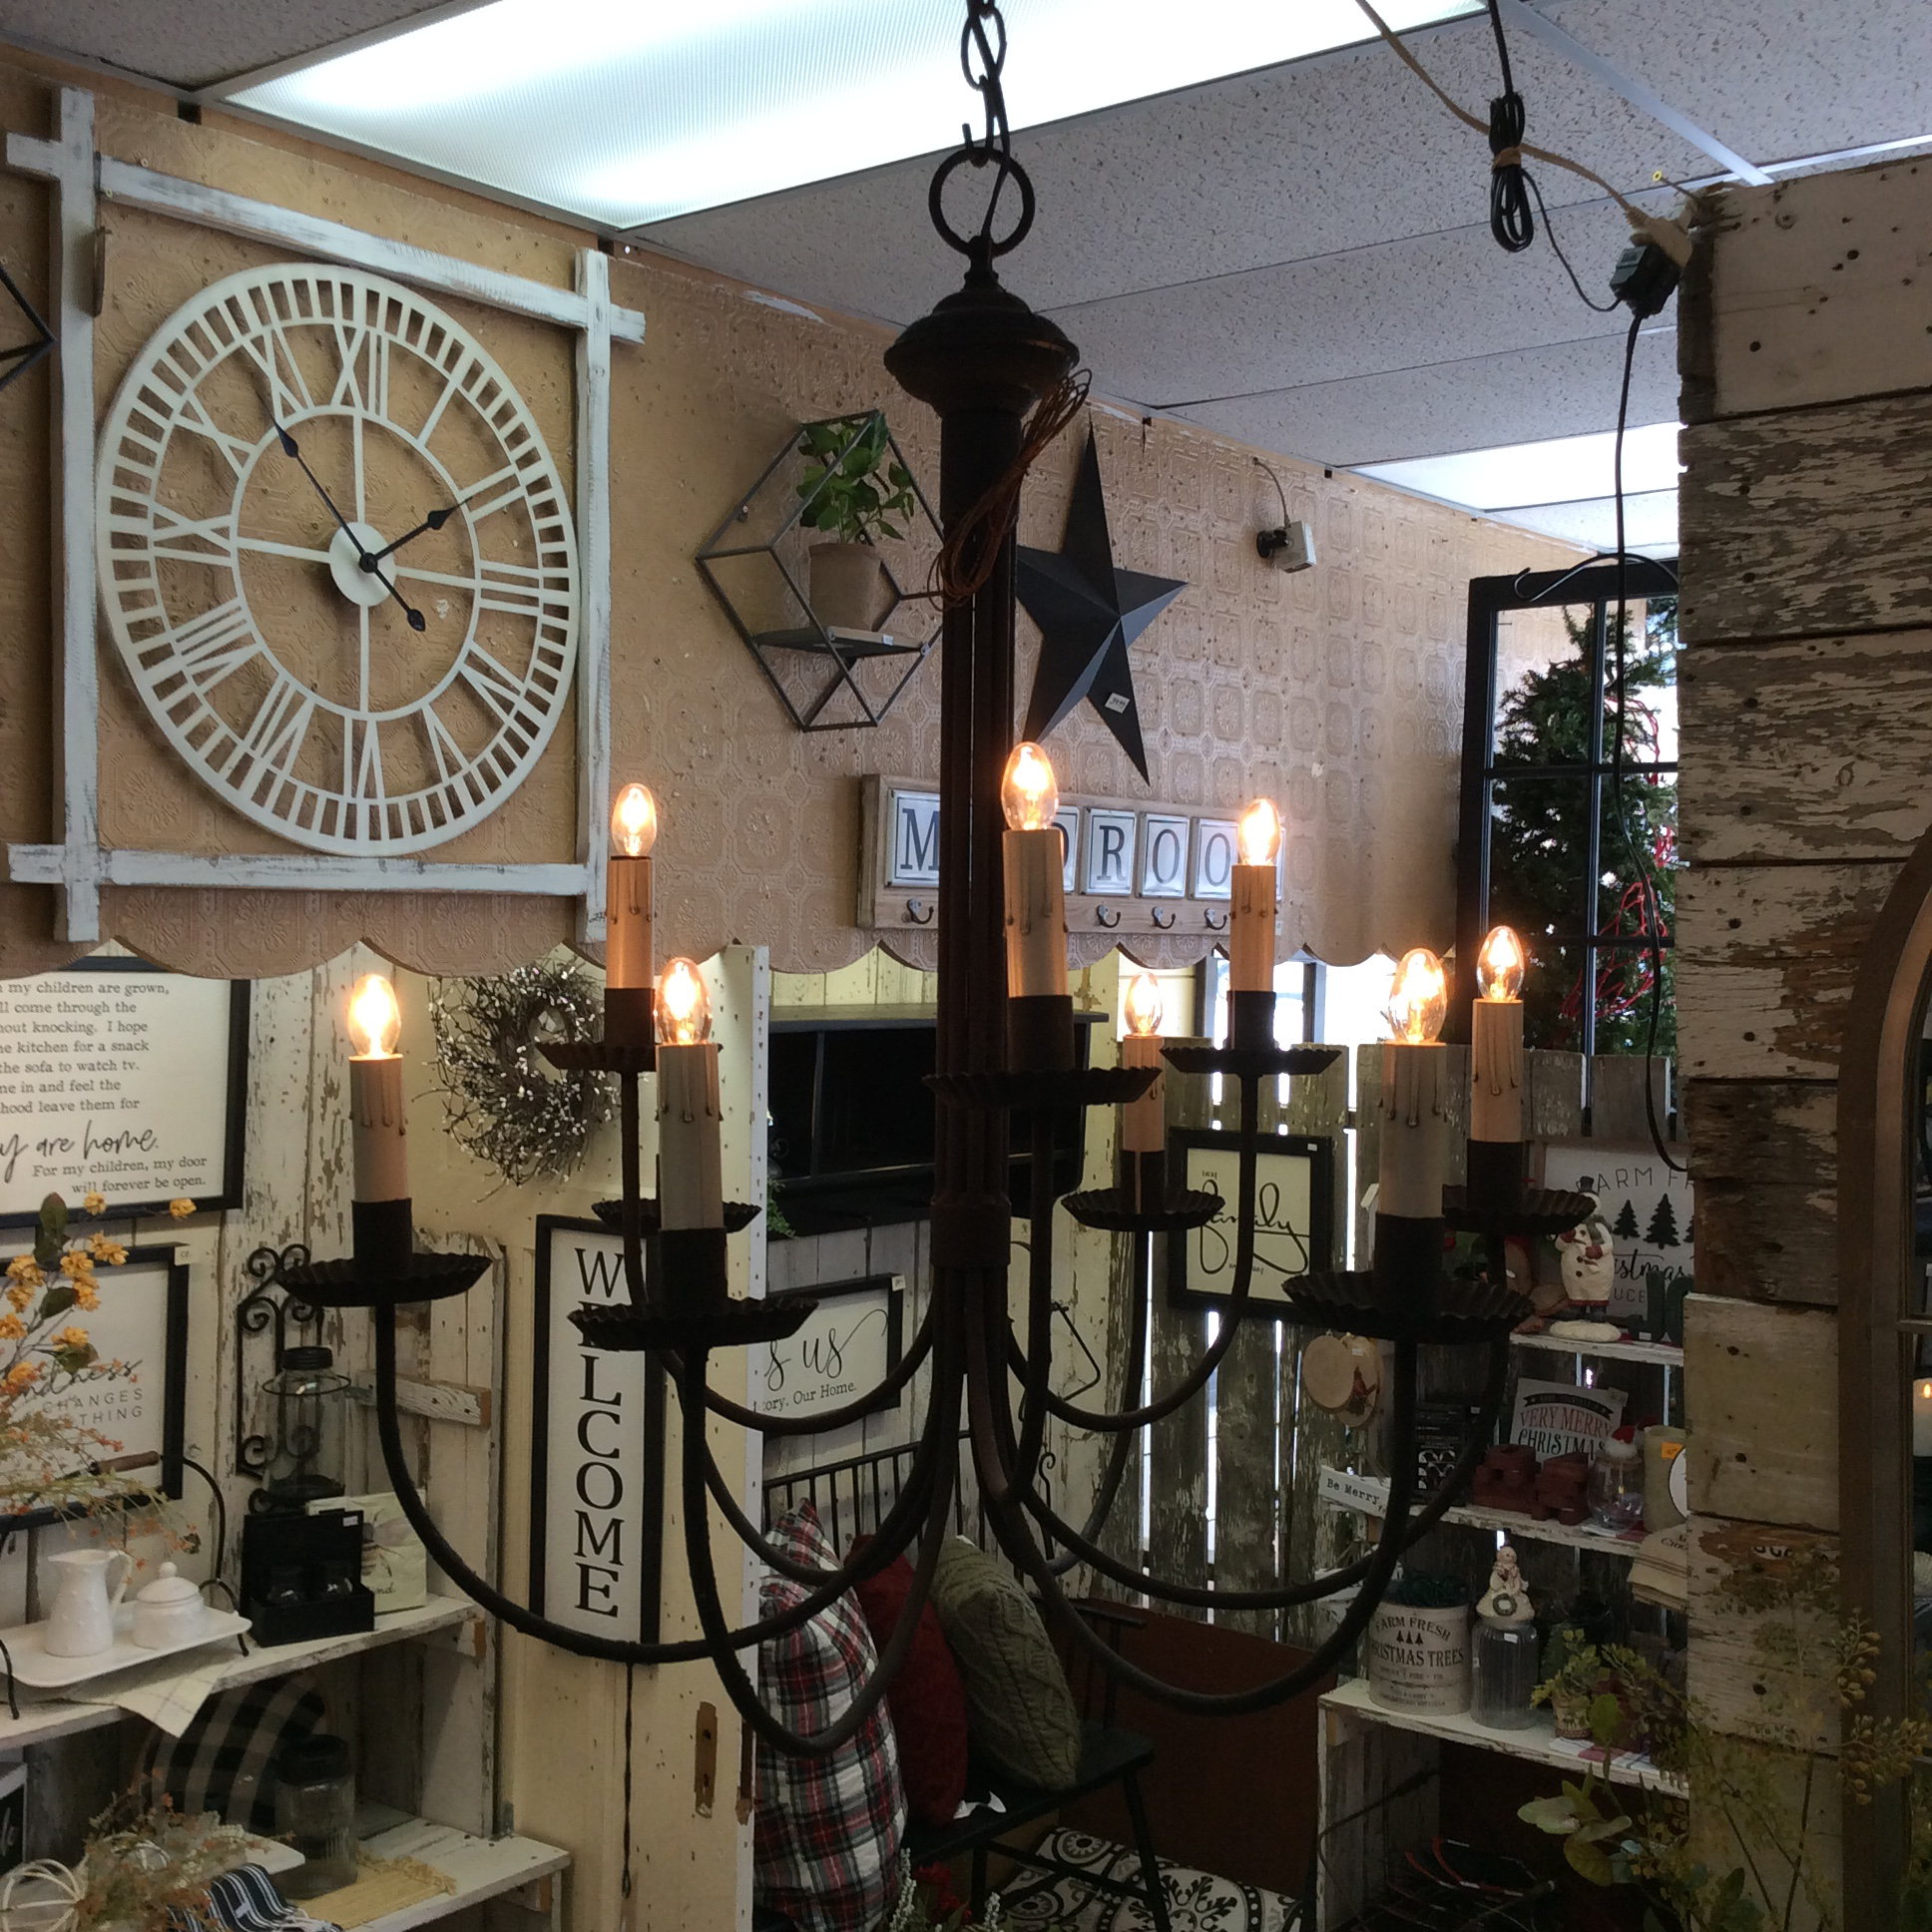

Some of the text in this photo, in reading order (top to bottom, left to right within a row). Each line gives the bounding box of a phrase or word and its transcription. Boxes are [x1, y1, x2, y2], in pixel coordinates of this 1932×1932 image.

[8, 984, 31, 996] my
[36, 981, 93, 994] children
[98, 984, 121, 994] are
[124, 984, 170, 996] grown,
[14, 1003, 52, 1014] come
[57, 1001, 110, 1016] through
[116, 1002, 137, 1014] the
[32, 1021, 98, 1036] knocking.
[107, 1020, 113, 1032] I
[117, 1021, 148, 1036] hope
[17, 1041, 69, 1054] kitchen
[74, 1040, 94, 1053] for
[98, 1043, 106, 1052] a
[111, 1041, 150, 1052] snack
[24, 1061, 53, 1074] sofa
[59, 1062, 72, 1073] to
[77, 1060, 118, 1072] watch
[122, 1062, 140, 1073] tv.
[21, 1082, 34, 1094] in
[39, 1081, 65, 1093] and
[69, 1079, 95, 1092] feel
[99, 1079, 122, 1091] the
[38, 1100, 76, 1113] leave
[80, 1099, 116, 1112] them
[120, 1098, 140, 1111] for
[36, 1137, 75, 1158] are
[83, 1119, 160, 1161] home.
[32, 1157, 208, 1178] For my children, my door
[72, 1177, 207, 1195] will forever be open.
[1597, 1166, 1654, 1193] ARM
[1200, 1180, 1309, 1274] faily
[1614, 1288, 1647, 1303] UCE
[42, 1388, 144, 1413] CHANGES
[763, 1381, 856, 1412] ory. Our Home.
[79, 1406, 144, 1426] THING
[1520, 1406, 1559, 1429] VERY
[1560, 1407, 1611, 1439] MERRY
[574, 1247, 625, 1618] WLCOME
[1326, 1478, 1340, 1491] Be
[1375, 1617, 1452, 1642] FARM FRESH
[1426, 1647, 1464, 1668] TREES
